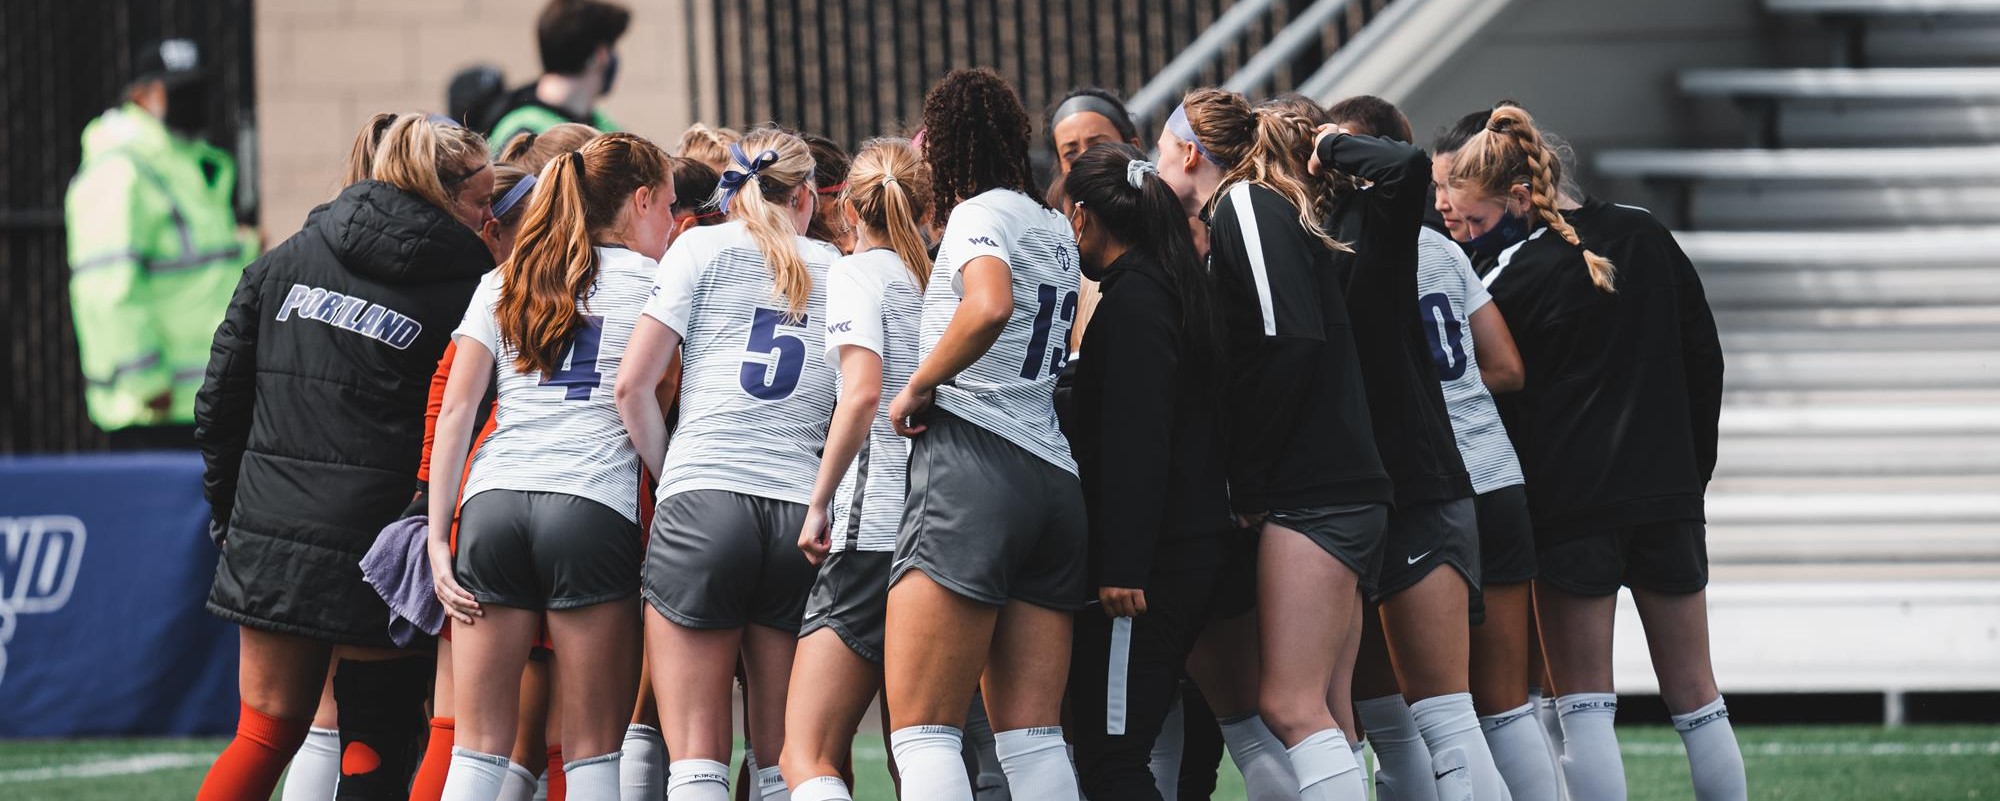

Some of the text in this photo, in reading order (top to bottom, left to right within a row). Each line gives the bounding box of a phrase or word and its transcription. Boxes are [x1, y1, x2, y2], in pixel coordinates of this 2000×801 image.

[275, 283, 423, 350] PORTLAND
[537, 315, 605, 401] 4
[739, 306, 809, 401] 5
[1019, 282, 1078, 381] 13
